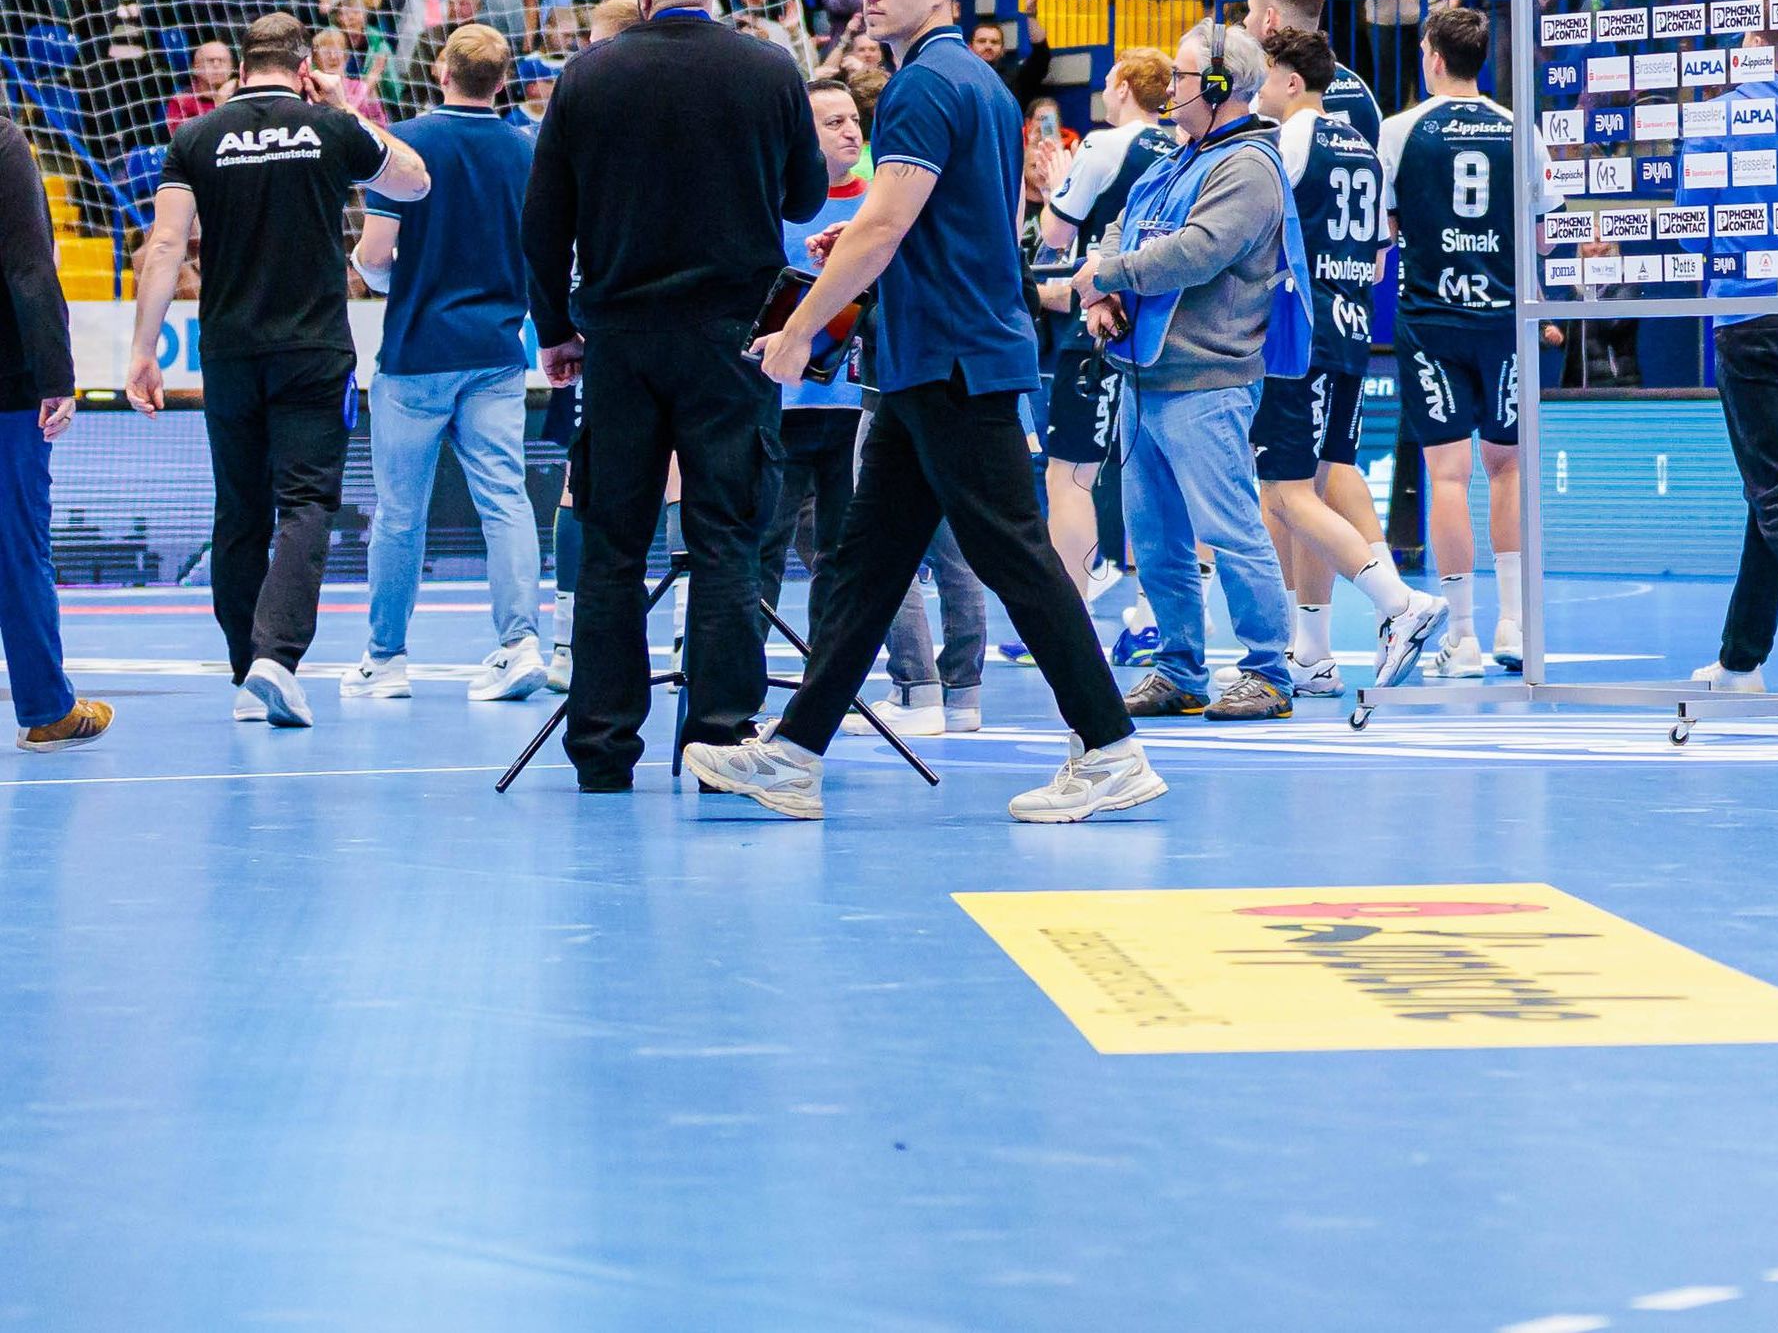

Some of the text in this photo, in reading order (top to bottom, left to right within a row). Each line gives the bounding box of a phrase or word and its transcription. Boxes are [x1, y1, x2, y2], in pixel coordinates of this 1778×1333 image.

[1667, 20, 1702, 32] CONTACT
[1725, 16, 1760, 28] CONTACT
[1555, 29, 1588, 40] CONTACT
[1610, 25, 1645, 36] CONTACT
[1684, 60, 1724, 76] ALPLA
[1741, 55, 1774, 70] Lippische
[1733, 109, 1774, 124] ALPLA
[1442, 119, 1512, 135] Lippische
[216, 125, 322, 155] ALPLA
[1553, 168, 1584, 183] Lippische
[1452, 150, 1490, 218] 8
[1328, 167, 1377, 241] 33
[1558, 227, 1591, 238] CONTACT
[1614, 225, 1648, 236] CONTACT
[1671, 222, 1706, 234] CONTACT
[1729, 220, 1764, 231] CONTACT
[1441, 228, 1500, 253] Simak
